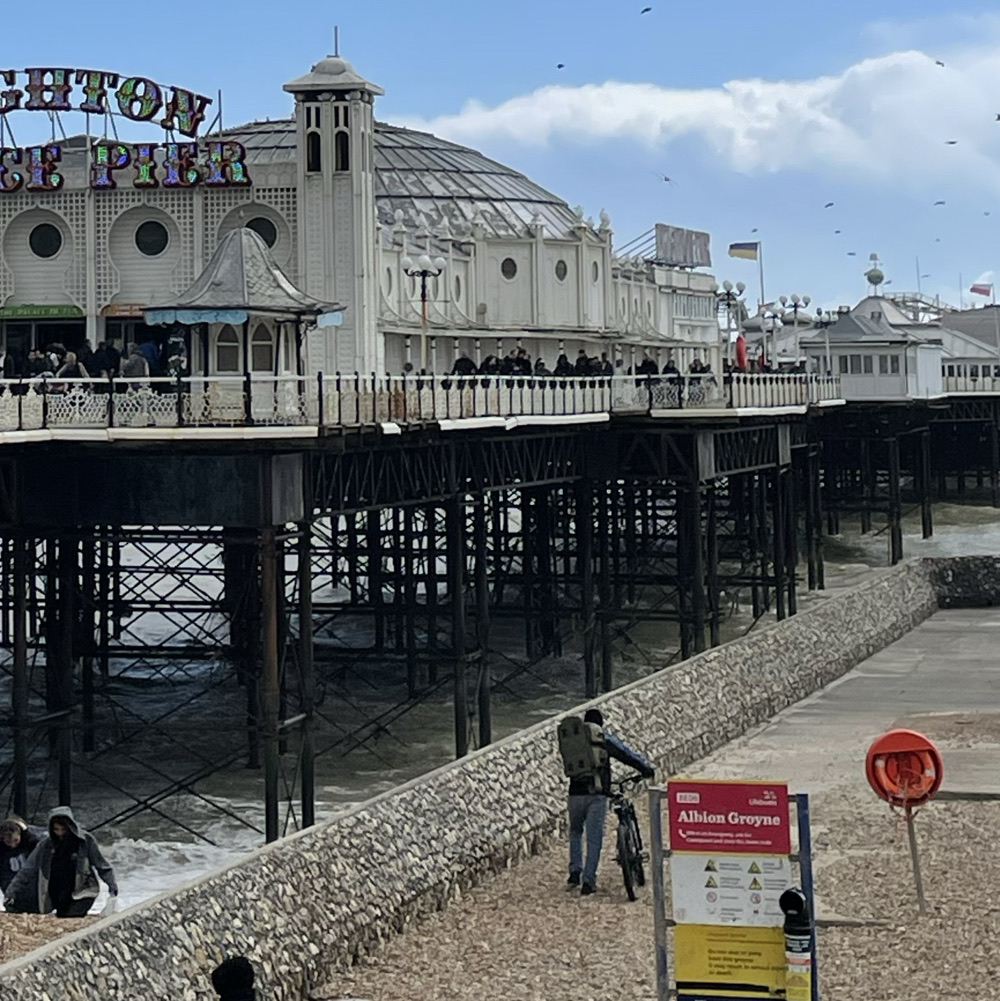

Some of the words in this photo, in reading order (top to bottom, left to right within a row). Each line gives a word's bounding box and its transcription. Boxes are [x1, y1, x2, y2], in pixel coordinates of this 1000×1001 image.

[91, 141, 252, 189] PIER
[678, 810, 726, 823] Albion
[728, 811, 781, 828] Groyne
